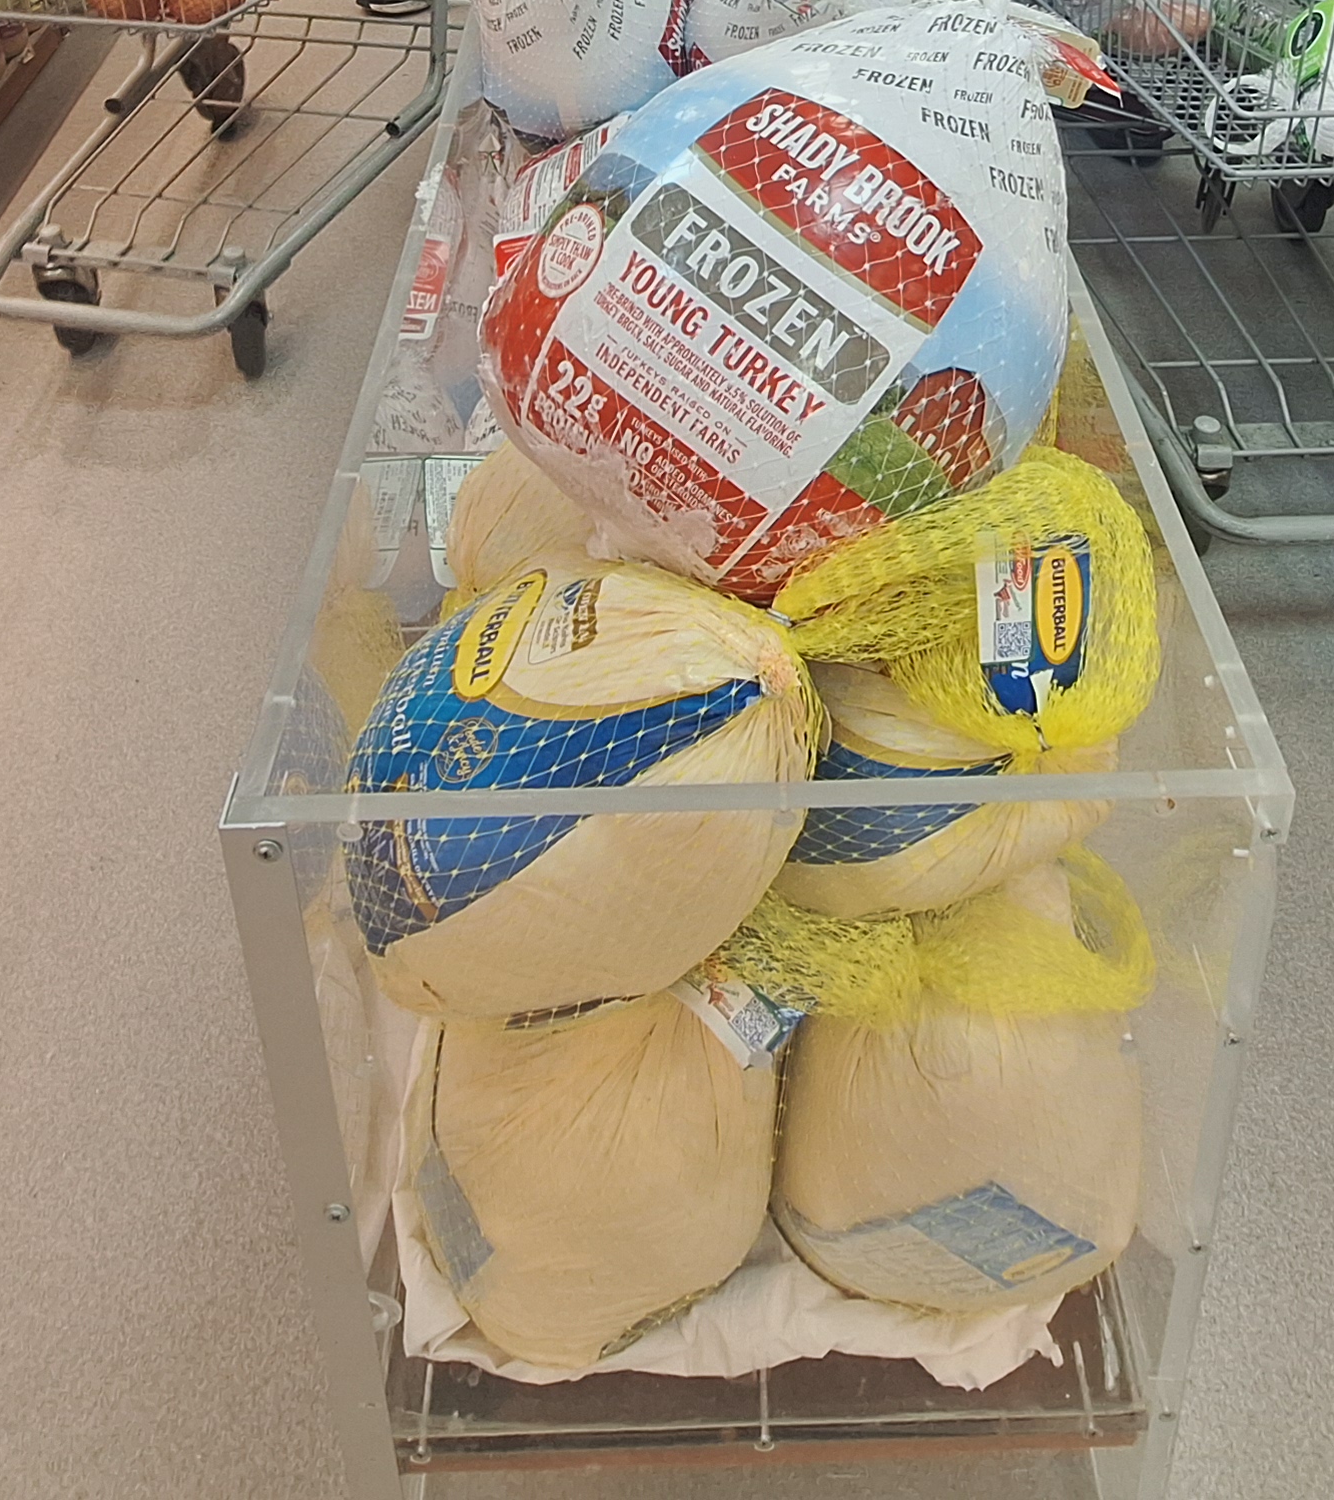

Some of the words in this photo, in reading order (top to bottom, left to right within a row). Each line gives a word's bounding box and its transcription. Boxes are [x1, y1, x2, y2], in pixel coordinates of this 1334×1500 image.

[506, 24, 544, 55] FROZEN
[572, 15, 599, 61] FROZEN
[790, 42, 885, 60] FROZEN
[926, 13, 999, 37] FROZEN
[851, 67, 934, 95] FROZEN
[953, 88, 995, 105] FROZEN
[920, 106, 992, 144] FROZEN
[744, 102, 861, 181] SHADY
[842, 163, 961, 277] BROOK
[770, 162, 872, 246] FARMS
[988, 165, 1046, 202] FROZEN
[663, 211, 850, 372] FROZEN
[618, 250, 710, 341] YOUNG
[706, 323, 827, 425] TURKEY
[549, 359, 609, 424] 22g
[594, 342, 691, 425] INDEPENDENT
[688, 413, 742, 465] FARMS
[641, 314, 665, 340] WITH
[745, 398, 789, 437] SOLUTION
[786, 429, 803, 445] OF
[663, 350, 692, 382] SUGAR
[689, 372, 711, 395] AND
[708, 386, 747, 426] NATURAL
[670, 384, 711, 420] RAISED
[713, 420, 732, 437] ON
[620, 426, 655, 467] NO
[467, 579, 538, 687] BUTTERBALL
[1050, 556, 1067, 655] BUTTERBALL
